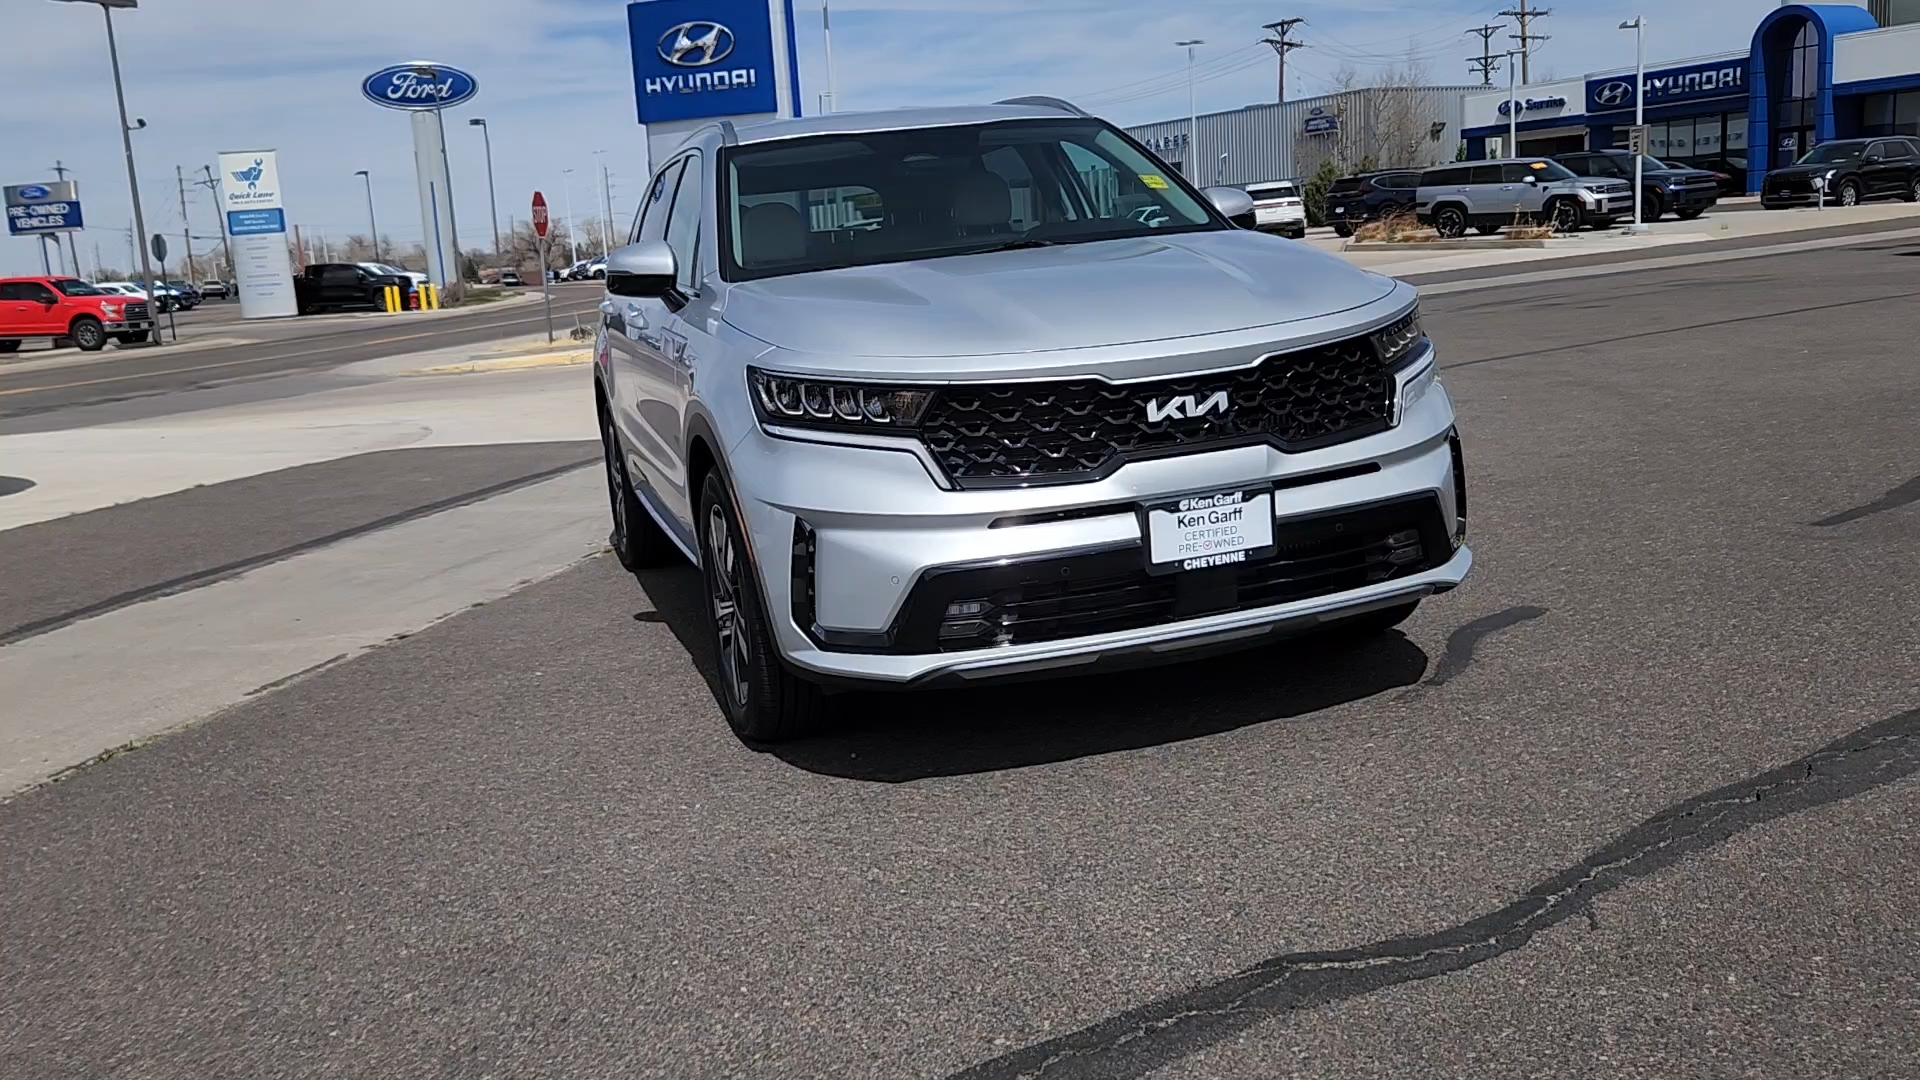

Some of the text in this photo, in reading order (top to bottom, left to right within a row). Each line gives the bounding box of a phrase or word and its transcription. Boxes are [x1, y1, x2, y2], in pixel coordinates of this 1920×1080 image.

[386, 71, 454, 99] Ford
[645, 68, 756, 96] HYUNDAI
[1643, 66, 1742, 97] HYUNDAI
[1525, 97, 1566, 111] Service
[1633, 141, 1639, 152] 5
[229, 191, 275, 200] Quick Lane
[8, 203, 70, 217] PRE-OWNED
[532, 205, 546, 223] STOP
[14, 215, 65, 228] VEHICLES
[1146, 391, 1229, 422] KIA
[1189, 491, 1243, 510] Ken Garff
[1177, 507, 1243, 529] Ken Garff
[1184, 525, 1238, 542] CERTIFIED
[1178, 536, 1245, 554] PRE-OWNED
[1183, 550, 1246, 570] CHEYENNE
